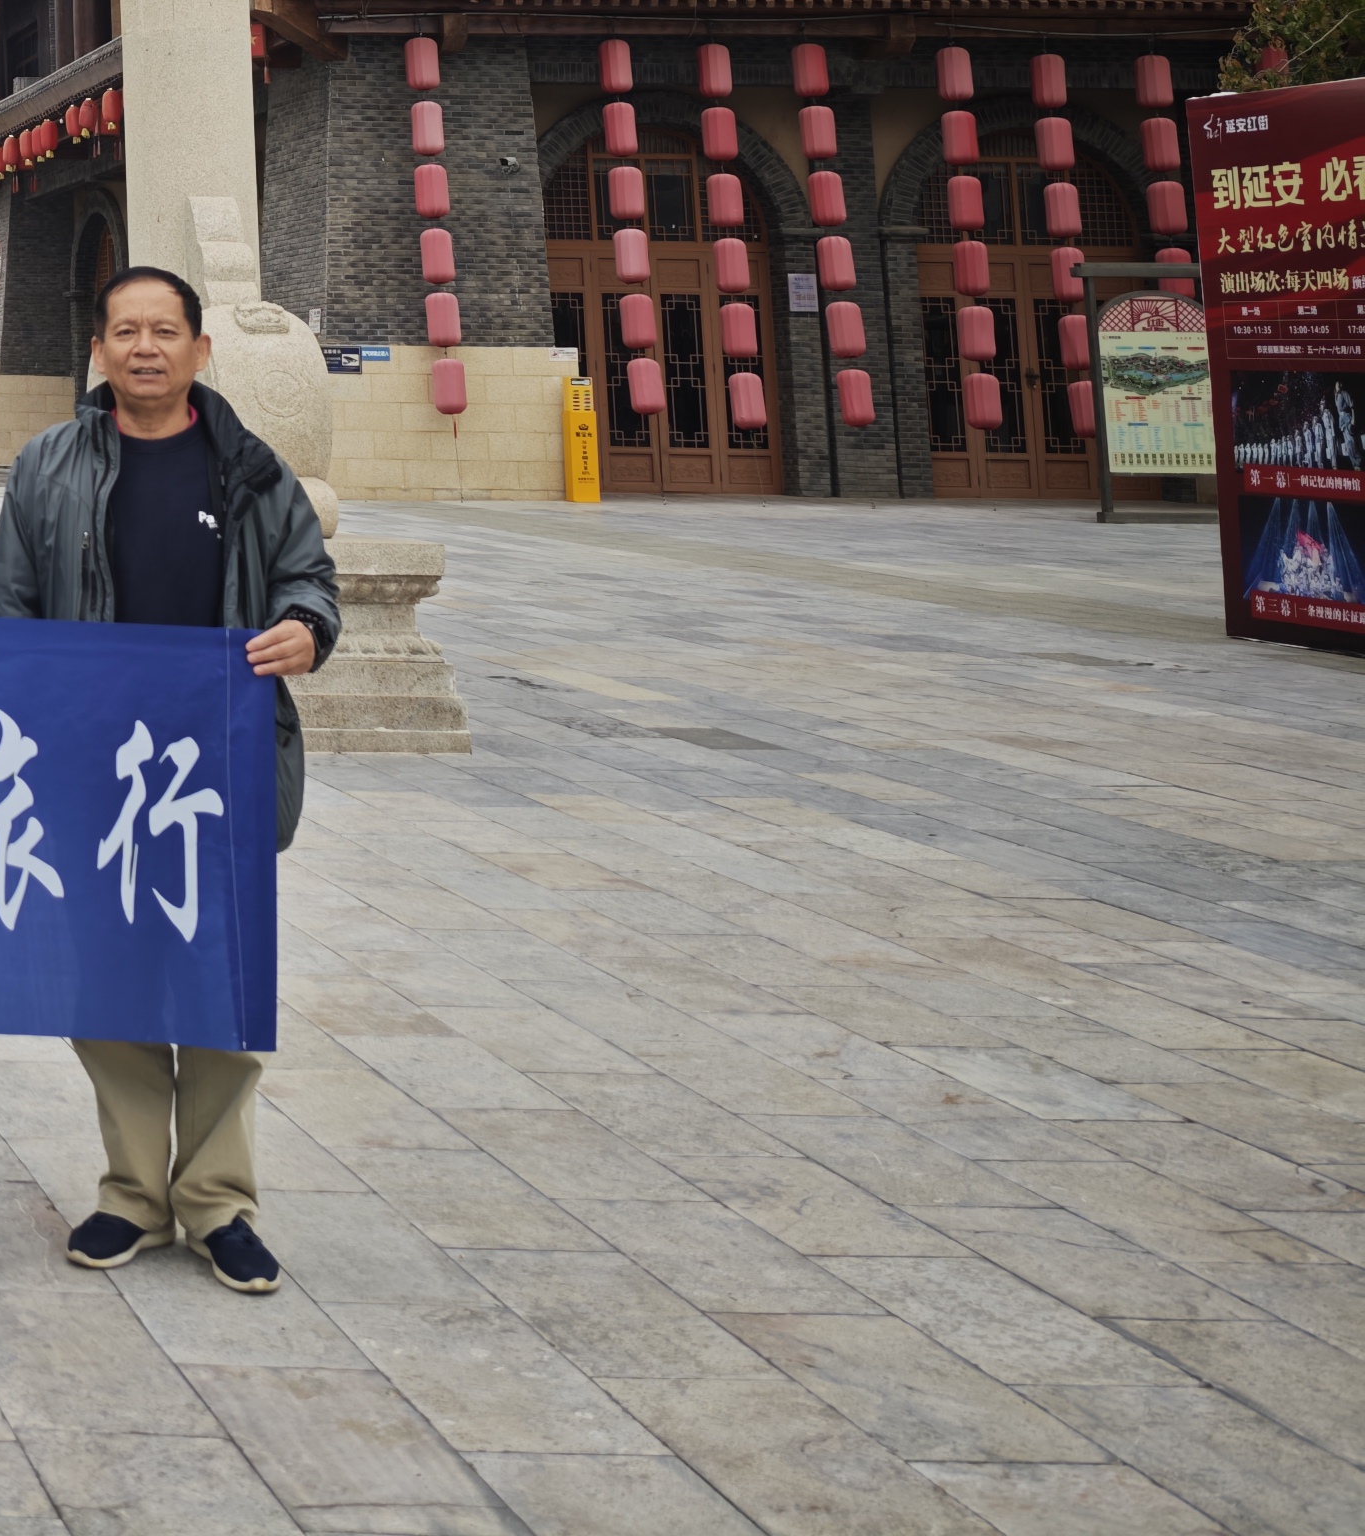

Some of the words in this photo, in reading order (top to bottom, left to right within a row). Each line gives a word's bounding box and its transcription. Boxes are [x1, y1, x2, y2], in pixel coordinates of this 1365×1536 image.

[1225, 114, 1269, 134] 延安红街
[1210, 161, 1305, 210] 到延安
[1217, 218, 1365, 254] 大型红色室内情
[1233, 325, 1272, 335] 10:30-11:35
[1289, 325, 1330, 334] 13:00-14:05
[1249, 469, 1287, 488] 第一幕
[1292, 474, 1361, 492] 一间记忆的博物馆
[1254, 595, 1292, 617] 第三幕
